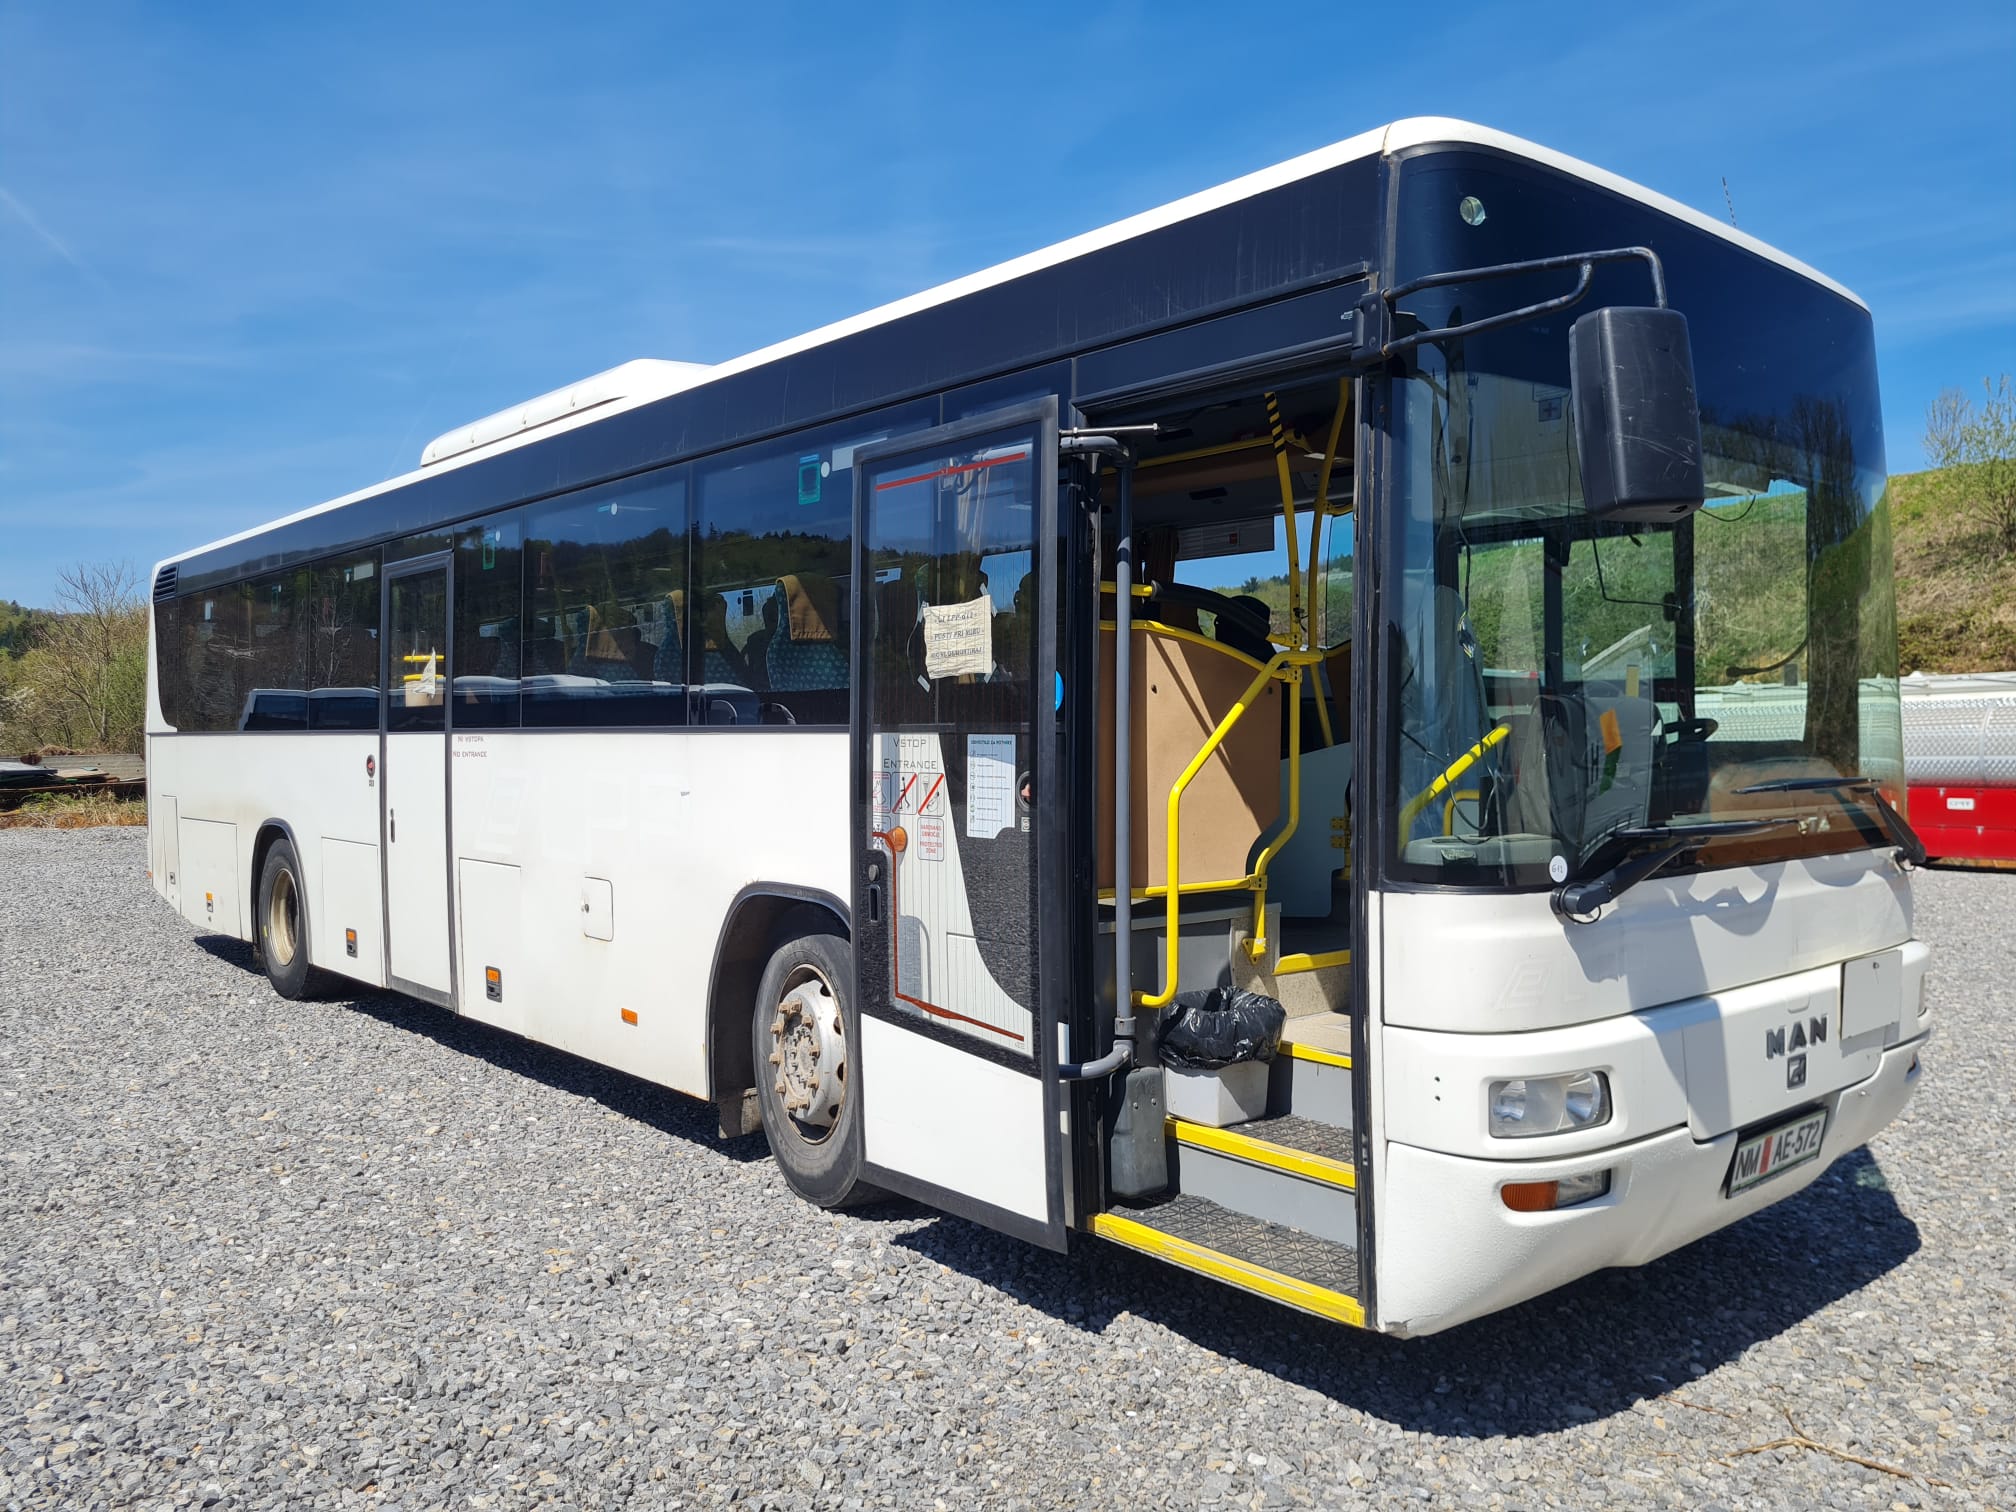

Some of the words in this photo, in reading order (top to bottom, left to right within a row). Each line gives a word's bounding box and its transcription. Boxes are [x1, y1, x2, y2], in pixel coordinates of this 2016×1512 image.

[465, 735, 484, 743] VSTOPA
[893, 737, 927, 748] VSTOP
[883, 758, 938, 770] ENTRANCE
[1765, 1015, 1828, 1059] MAN
[1735, 1143, 1762, 1181] NM
[1772, 1119, 1820, 1166] AE-572
